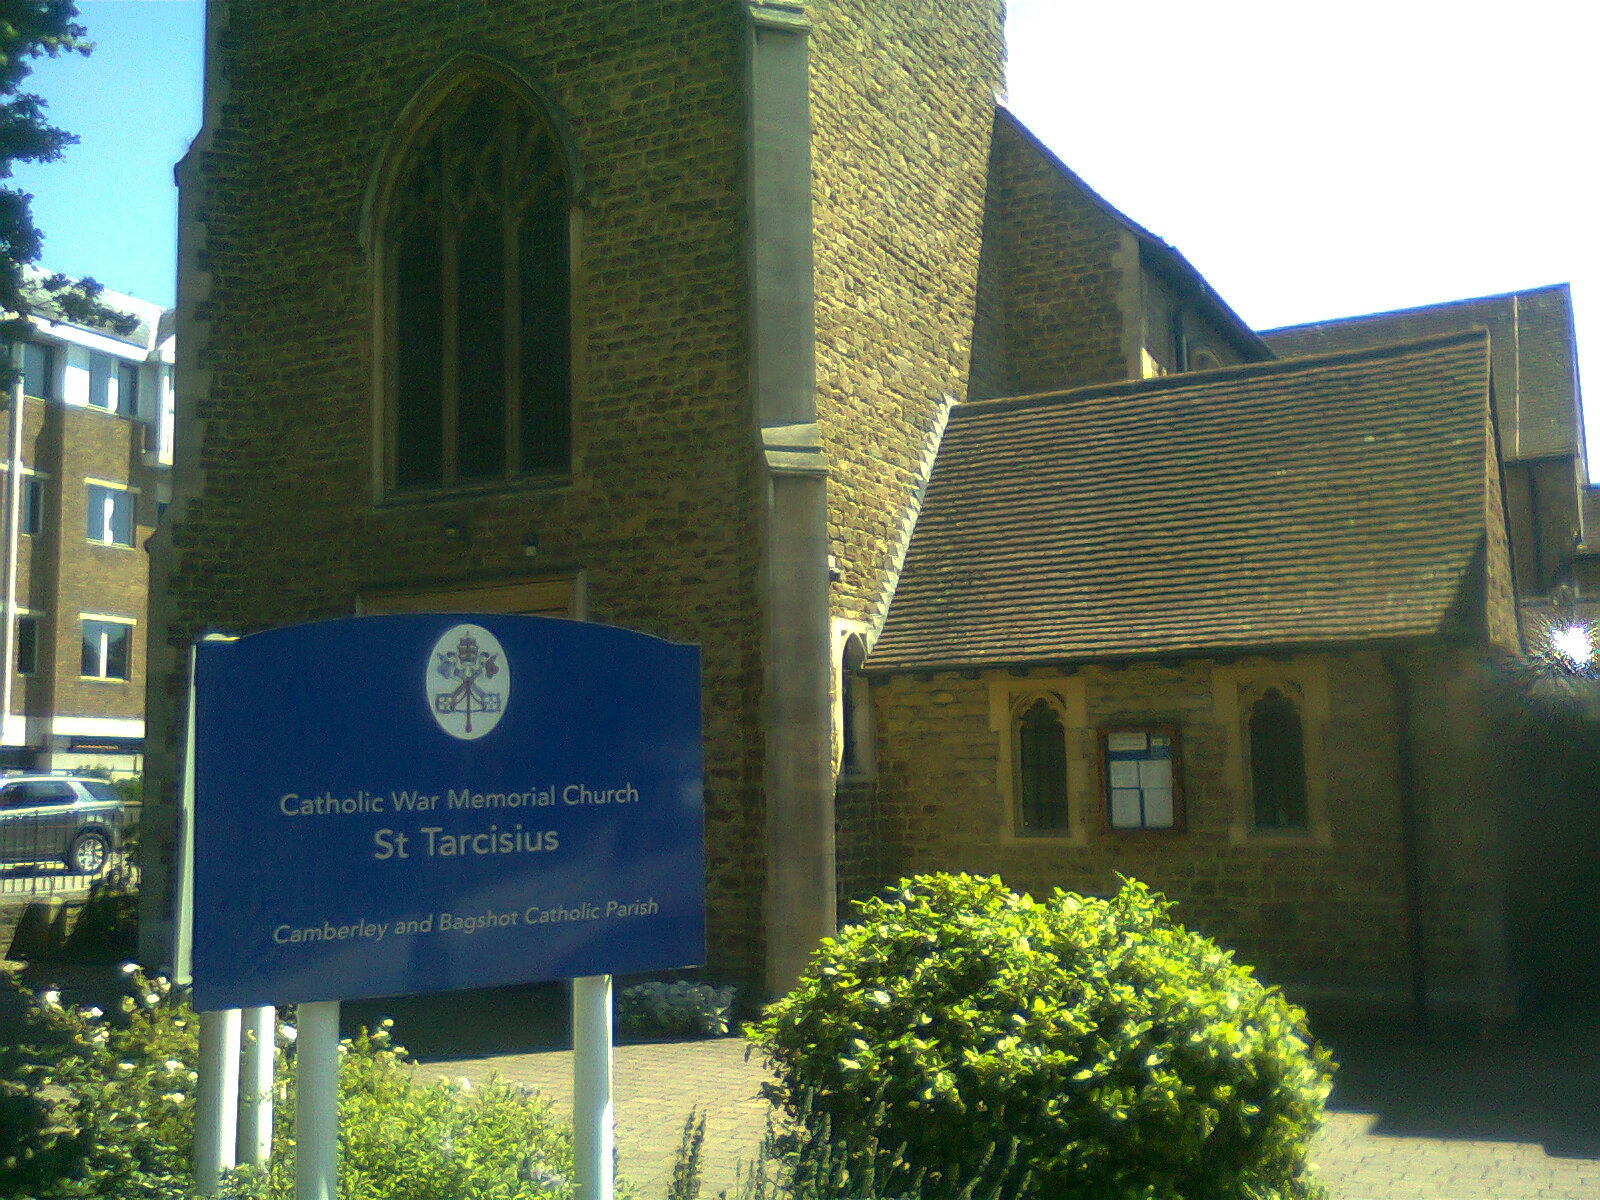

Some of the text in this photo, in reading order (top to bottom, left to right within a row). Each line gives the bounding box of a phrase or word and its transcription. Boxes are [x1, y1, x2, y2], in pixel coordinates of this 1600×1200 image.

[280, 783, 640, 817] Catholic War Memorial Church
[374, 824, 560, 860] St Tarcisius
[272, 897, 659, 945] Camberley and Bagshot Catholic Parish
